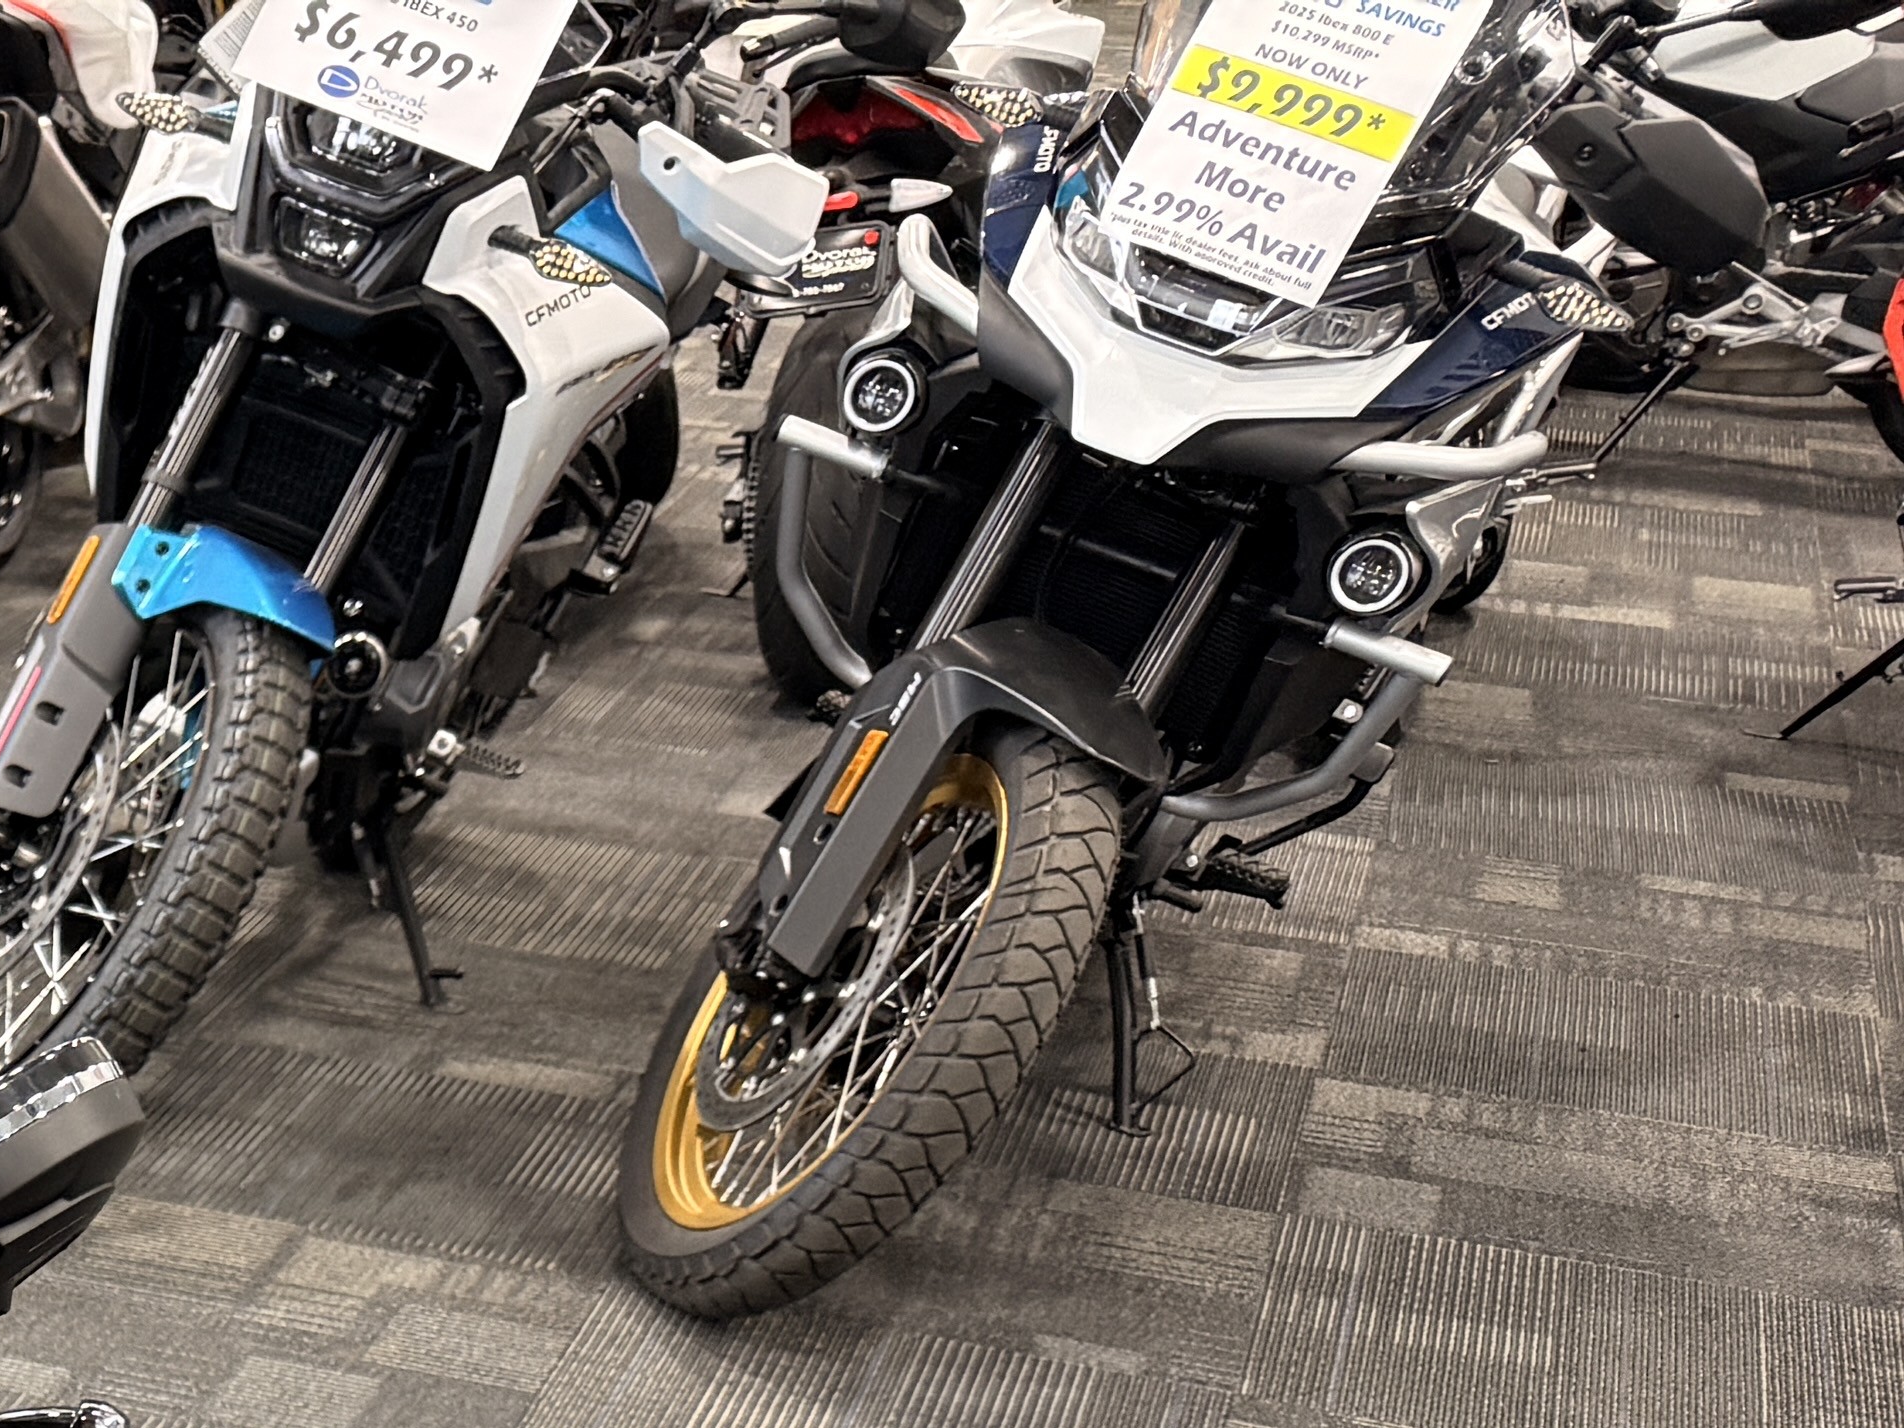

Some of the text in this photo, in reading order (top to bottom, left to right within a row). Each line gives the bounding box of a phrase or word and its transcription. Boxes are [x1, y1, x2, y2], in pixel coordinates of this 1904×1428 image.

[446, 12, 479, 33] 450
[1271, 19, 1331, 47] $10,299
[1279, 1, 1316, 21] 2025
[1352, 24, 1382, 42] 800
[1382, 34, 1395, 46] E
[1356, 0, 1446, 37] SAVINGS
[1255, 43, 1369, 90] NOW ONLY
[363, 76, 429, 110] Dvorak
[1168, 110, 1358, 192] Adventure
[1194, 160, 1286, 213] More
[1118, 181, 1327, 275] 2.99% Avail
[1262, 263, 1292, 283] about
[524, 284, 592, 327] CFMOTO
[1480, 291, 1537, 331] CFMOT
